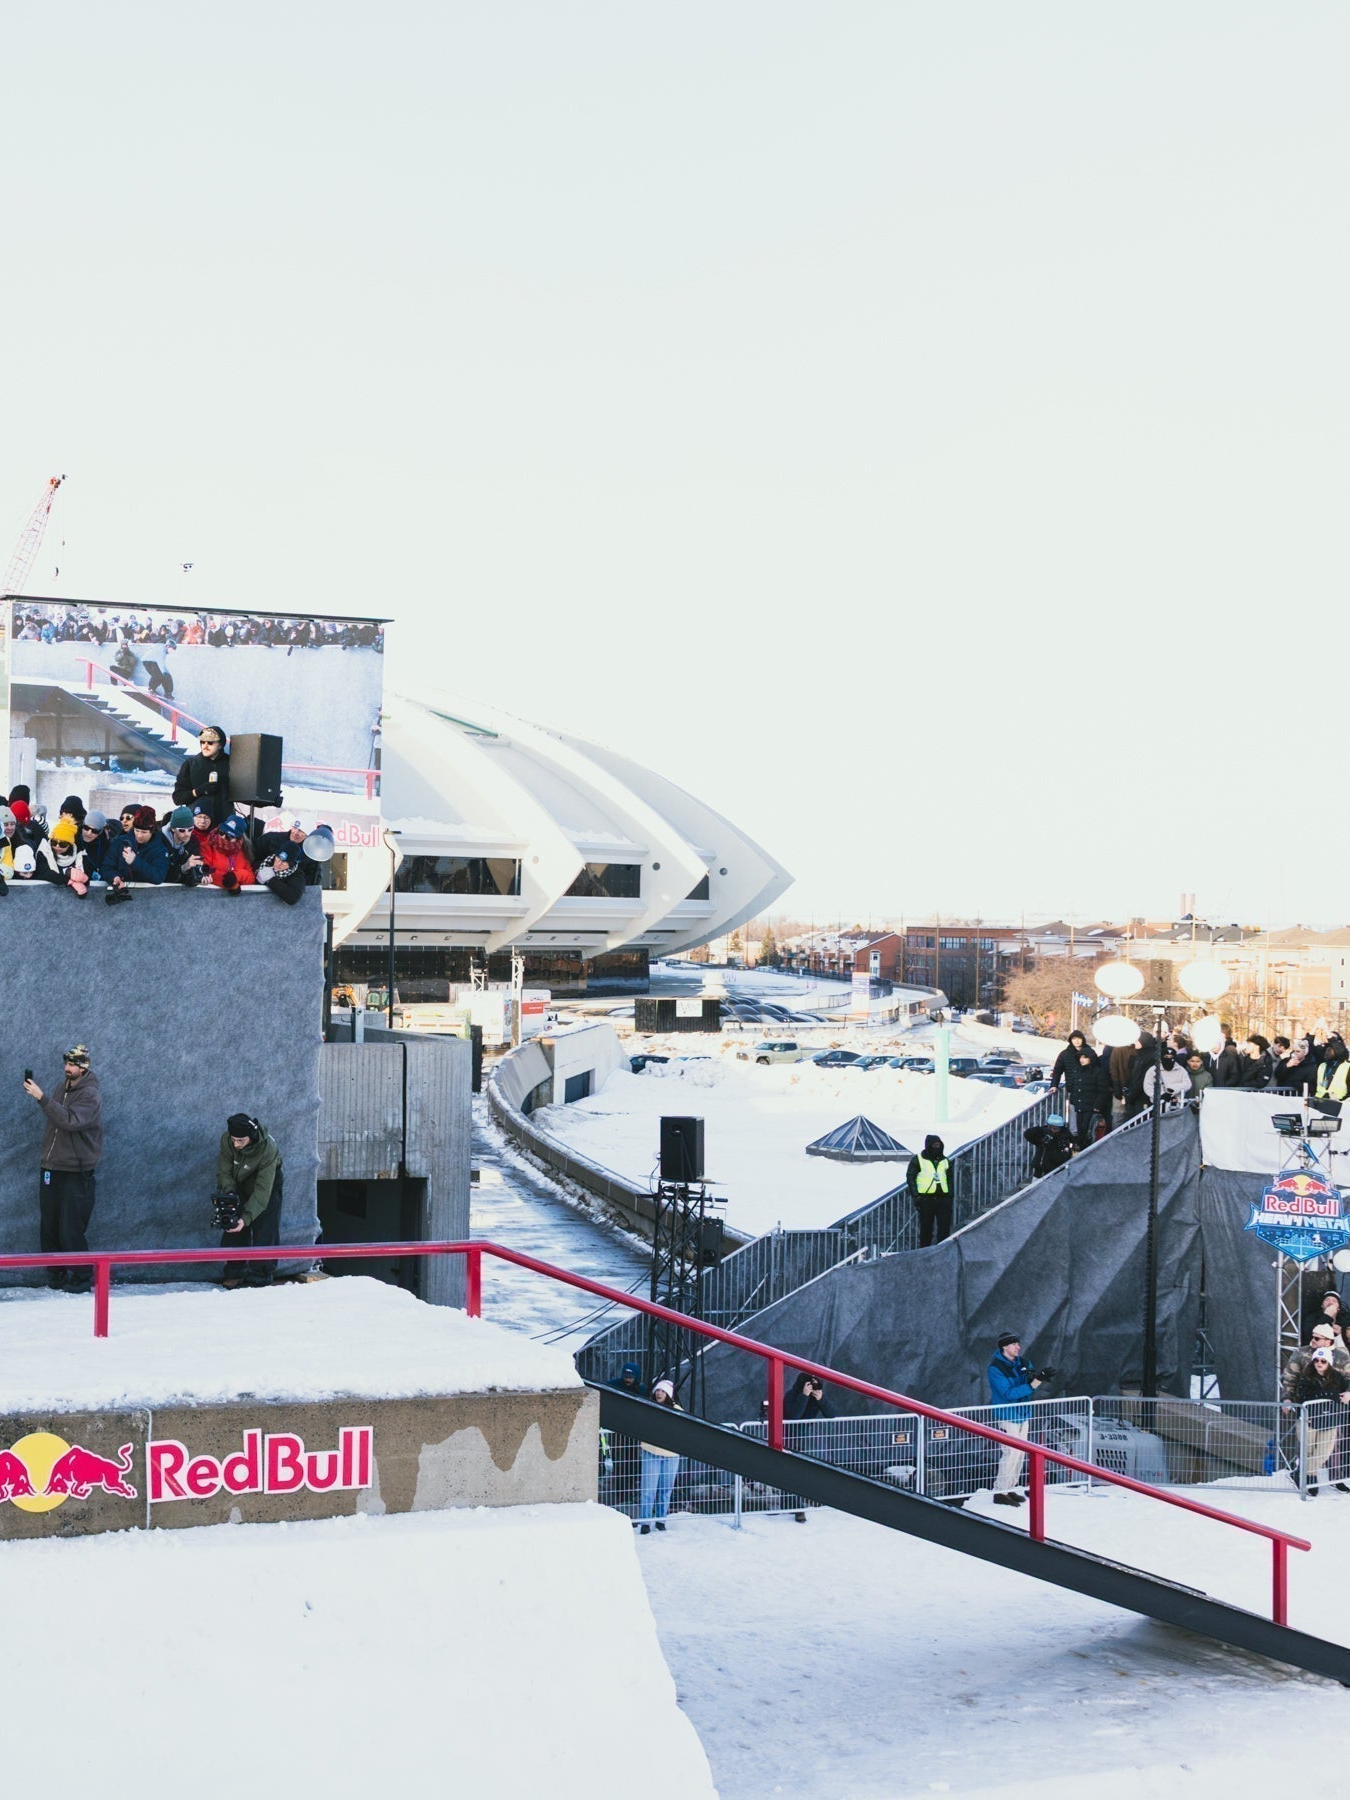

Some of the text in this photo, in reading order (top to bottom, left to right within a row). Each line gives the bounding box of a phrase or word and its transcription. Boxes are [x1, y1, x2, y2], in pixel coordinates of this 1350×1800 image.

[350, 824, 380, 846] Bull
[1266, 1195, 1338, 1216] Red Bull
[1250, 1209, 1304, 1227] HEAVY
[149, 1428, 371, 1501] Red Bull
